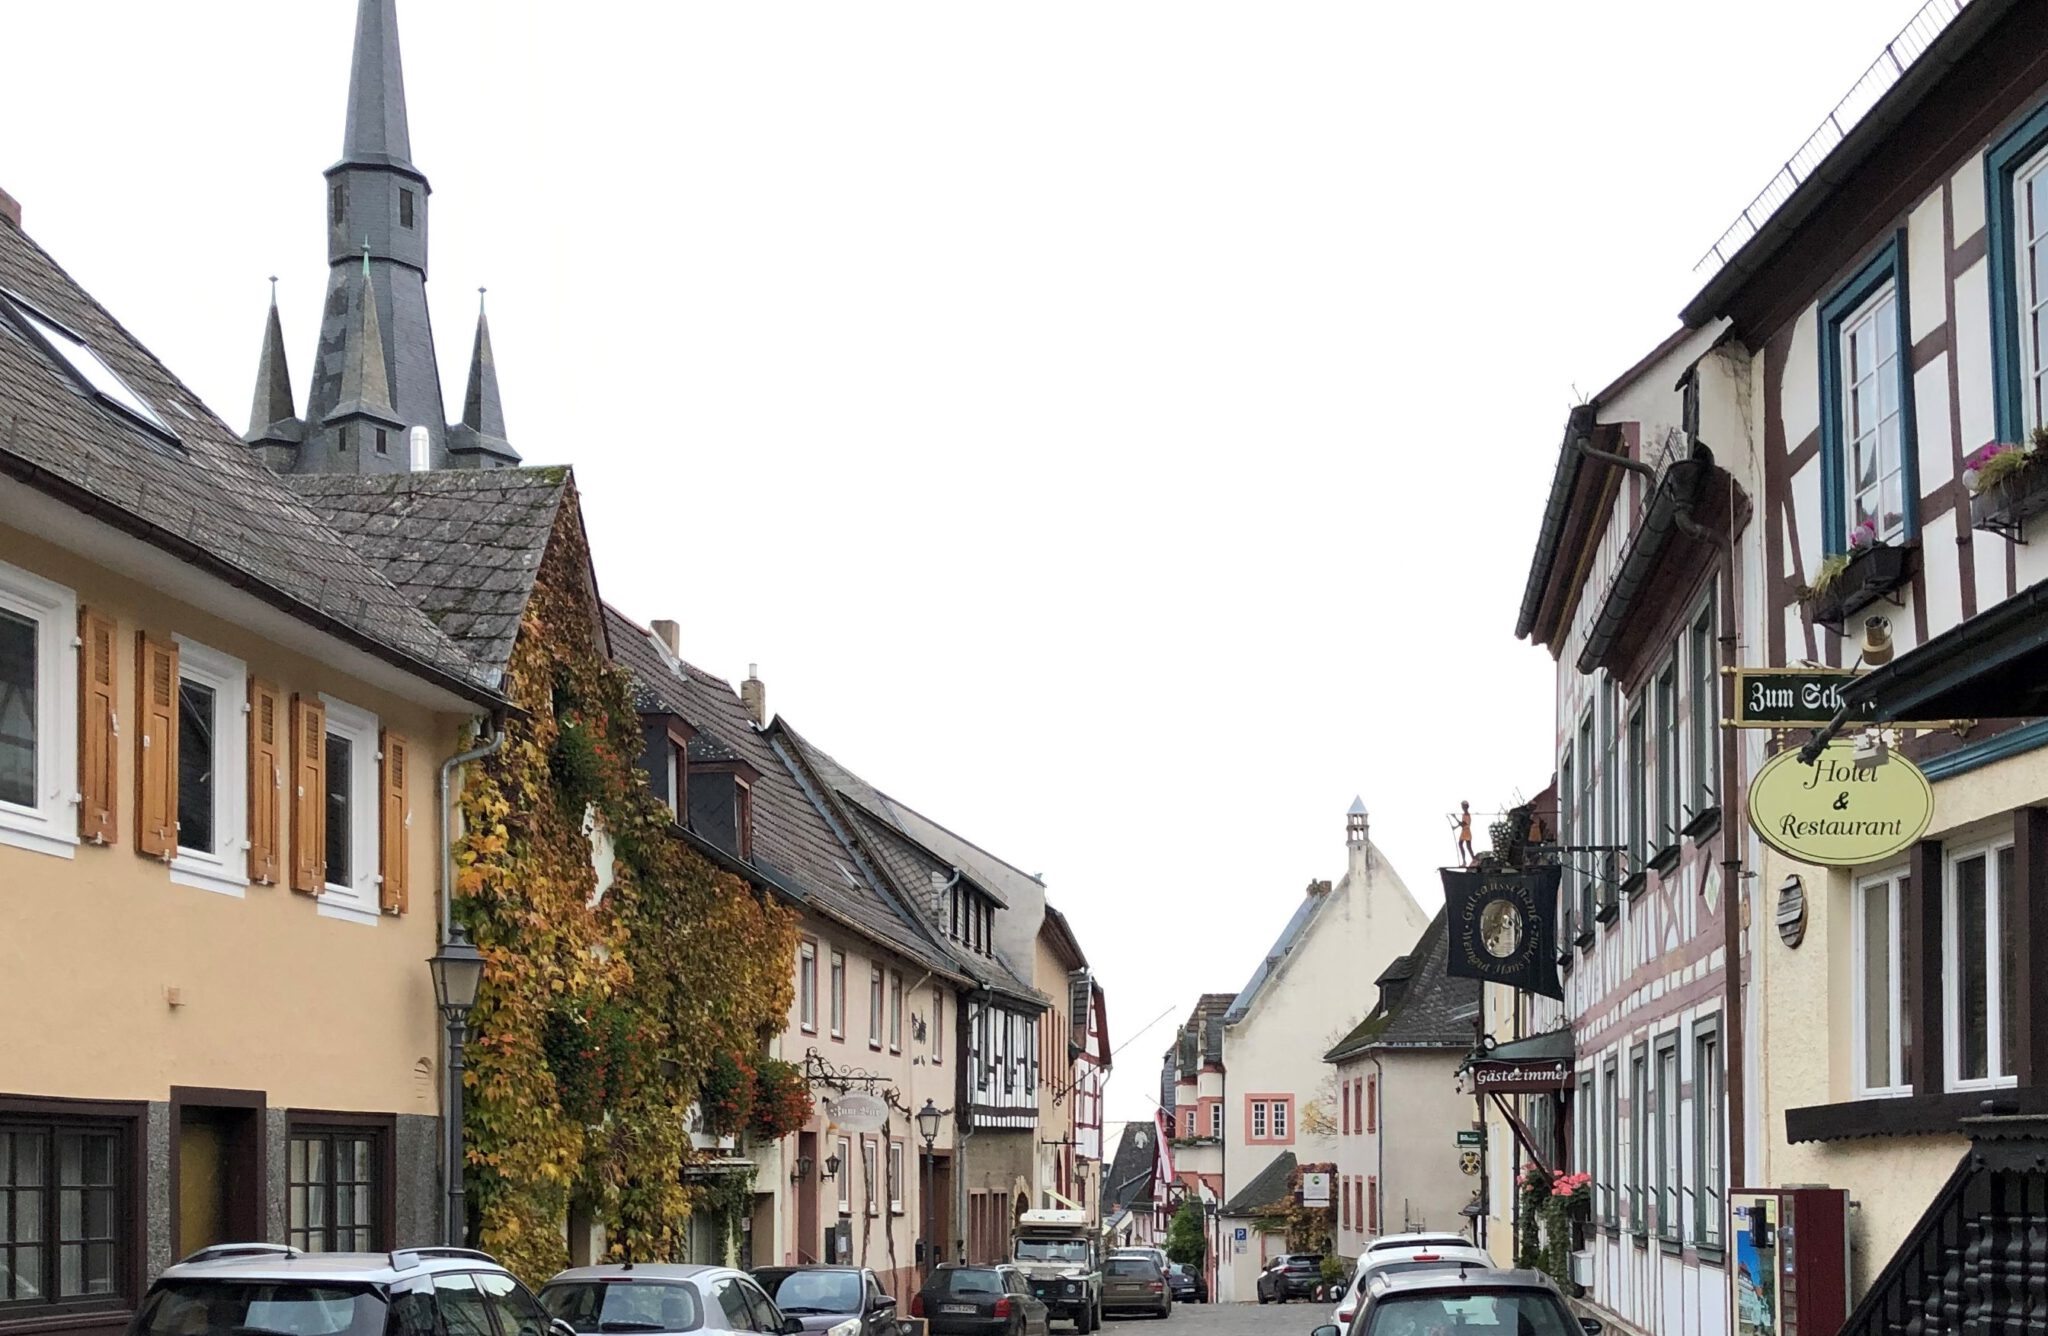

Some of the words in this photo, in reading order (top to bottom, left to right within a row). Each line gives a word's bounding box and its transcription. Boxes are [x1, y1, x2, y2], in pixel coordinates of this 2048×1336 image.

[1750, 682, 1794, 712] Zum
[1803, 759, 1878, 790] Hotel
[1832, 791, 1850, 811] &
[1779, 812, 1902, 839] Restaurant
[1237, 1229, 1245, 1239] P
